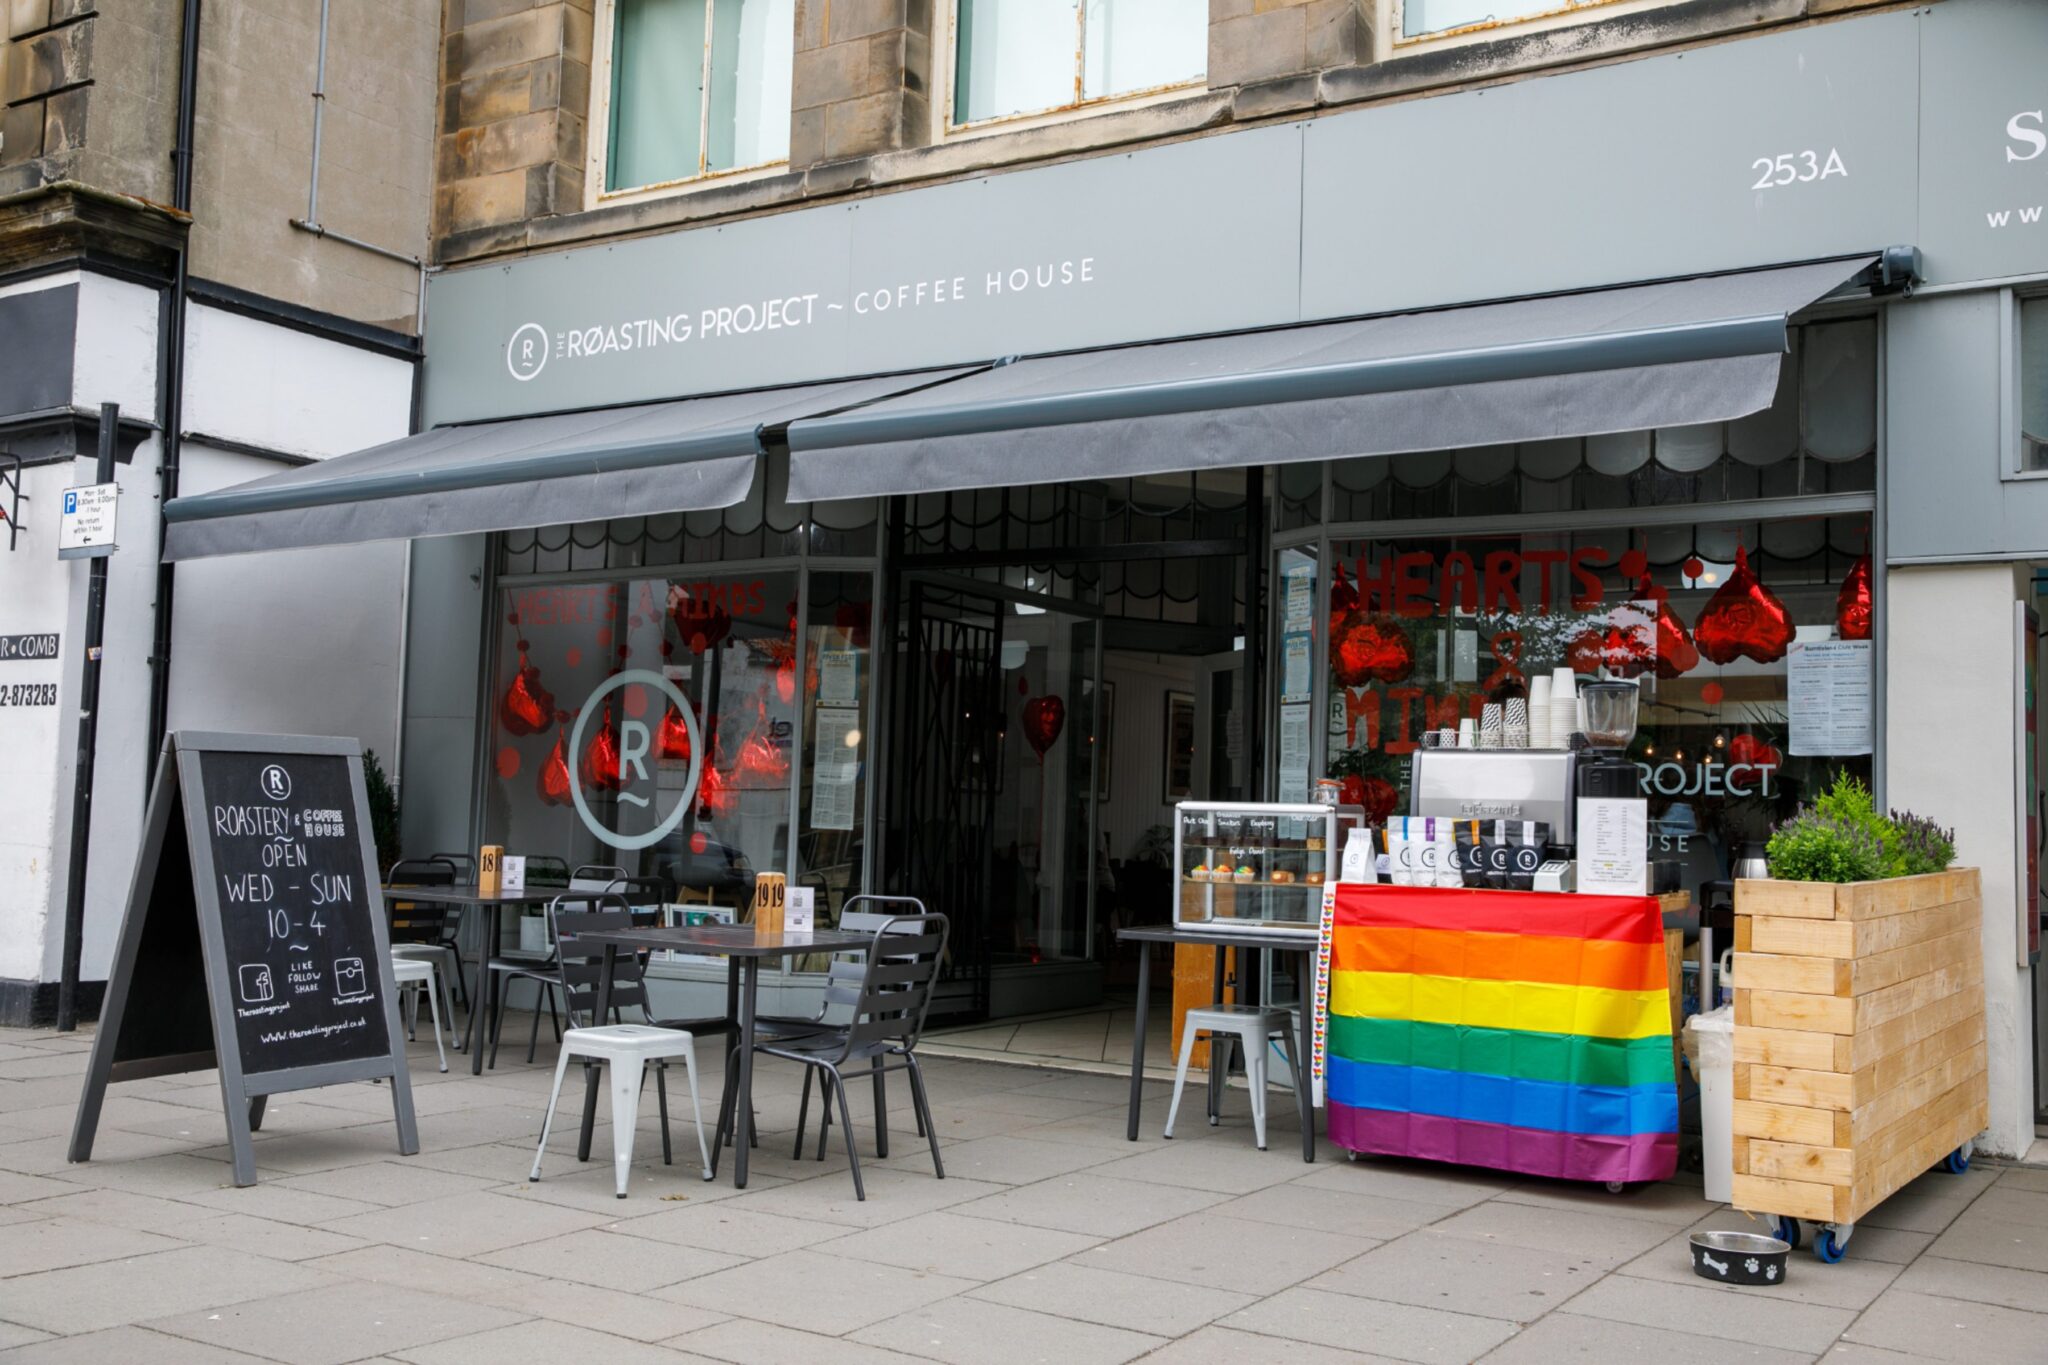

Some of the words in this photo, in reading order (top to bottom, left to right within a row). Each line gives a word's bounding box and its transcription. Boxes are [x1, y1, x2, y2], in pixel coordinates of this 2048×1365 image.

[1751, 148, 1848, 190] 253A
[568, 314, 692, 358] RØASTING
[700, 294, 819, 339] PROJECT
[854, 277, 965, 314] COFFEE
[986, 258, 1094, 295] HOUSE
[522, 339, 533, 359] R
[556, 331, 566, 359] THE
[1357, 546, 1609, 618] HEARTS
[517, 585, 619, 626] HEARTS
[19, 636, 56, 656] COMB
[618, 720, 651, 781] R
[269, 769, 284, 790] R
[1400, 760, 1411, 790] THE
[215, 805, 289, 836] ROASTERY
[303, 809, 343, 822] COFFEE
[262, 843, 308, 868] OPEN
[483, 853, 494, 873] 18
[224, 873, 274, 903] WED
[310, 873, 352, 905] SUN
[757, 882, 769, 908] 19
[772, 882, 785, 908] 19
[288, 972, 322, 984] FOLLOW
[290, 961, 313, 972] LIKE
[294, 983, 319, 994] SHARE
